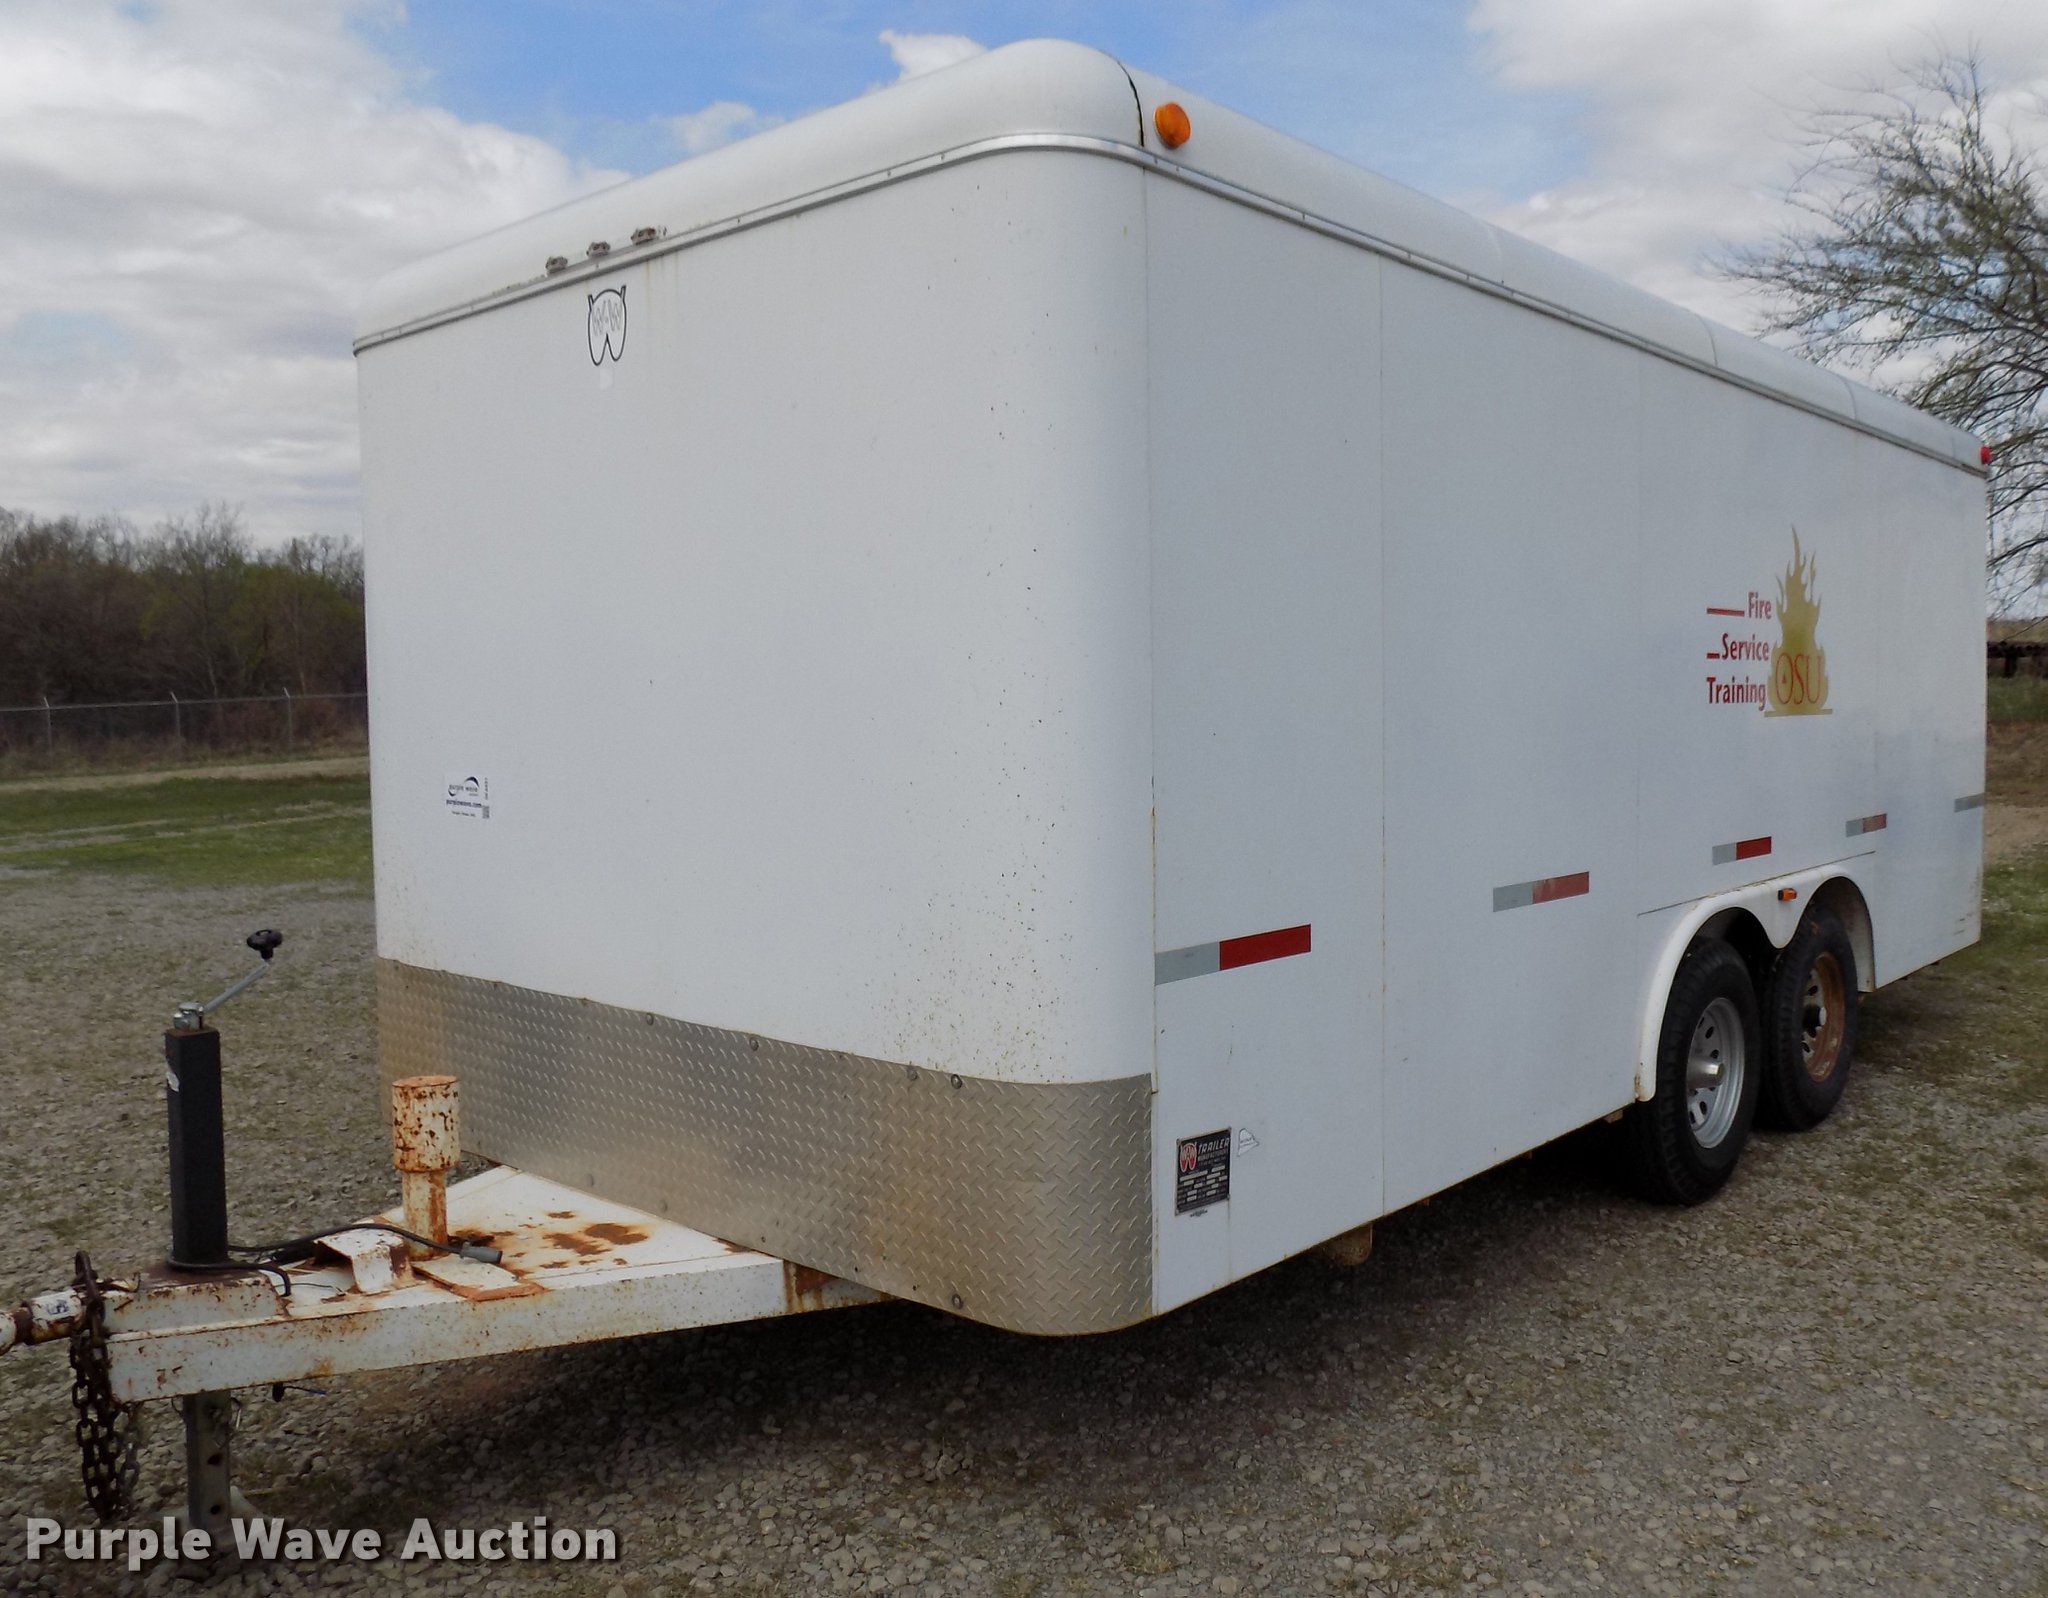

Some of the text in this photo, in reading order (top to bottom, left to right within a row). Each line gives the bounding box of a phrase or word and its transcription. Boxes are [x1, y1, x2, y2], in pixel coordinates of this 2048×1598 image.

[1748, 591, 1772, 620] Fire
[1721, 633, 1769, 661] Service
[1775, 652, 1822, 705] OSU
[1706, 676, 1766, 711] Training
[1198, 1137, 1230, 1155] TRAILER
